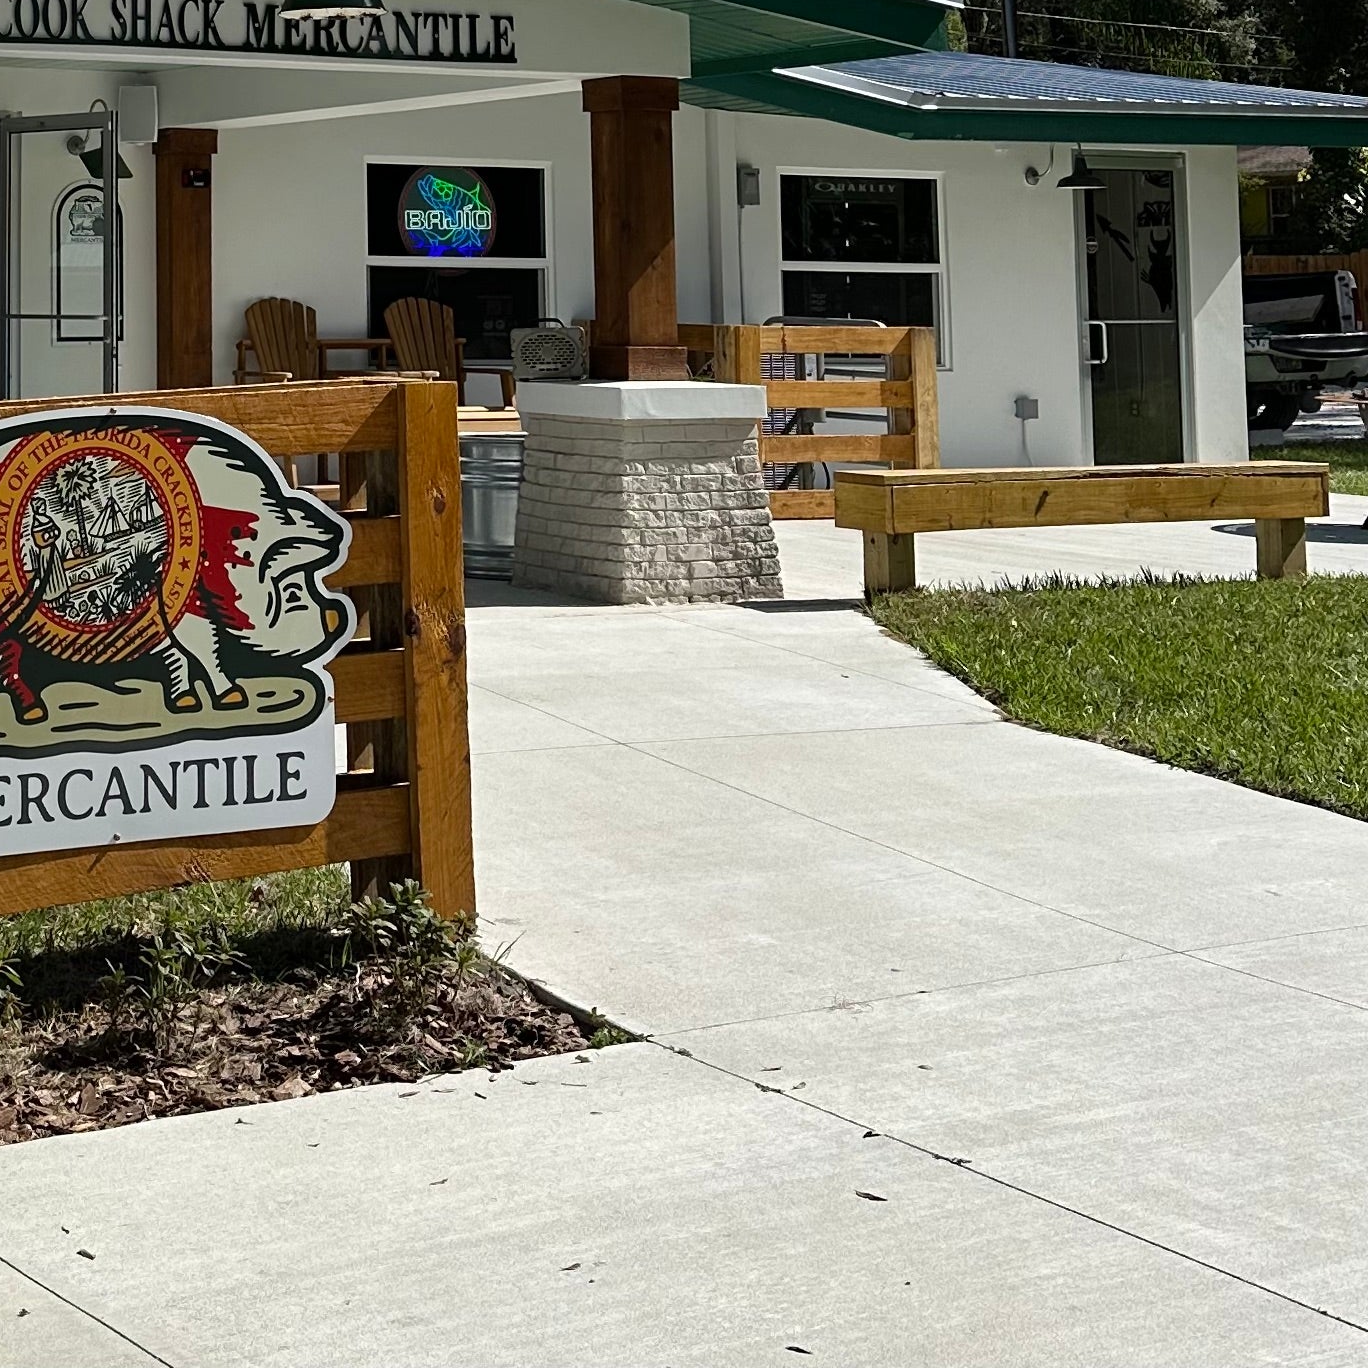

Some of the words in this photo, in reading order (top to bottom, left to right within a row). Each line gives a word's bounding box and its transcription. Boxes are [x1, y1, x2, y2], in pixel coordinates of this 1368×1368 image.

[243, 2, 517, 60] MERCANTILE
[7, 462, 31, 492] OF
[28, 433, 68, 465] THE
[153, 455, 196, 548] CRACKER
